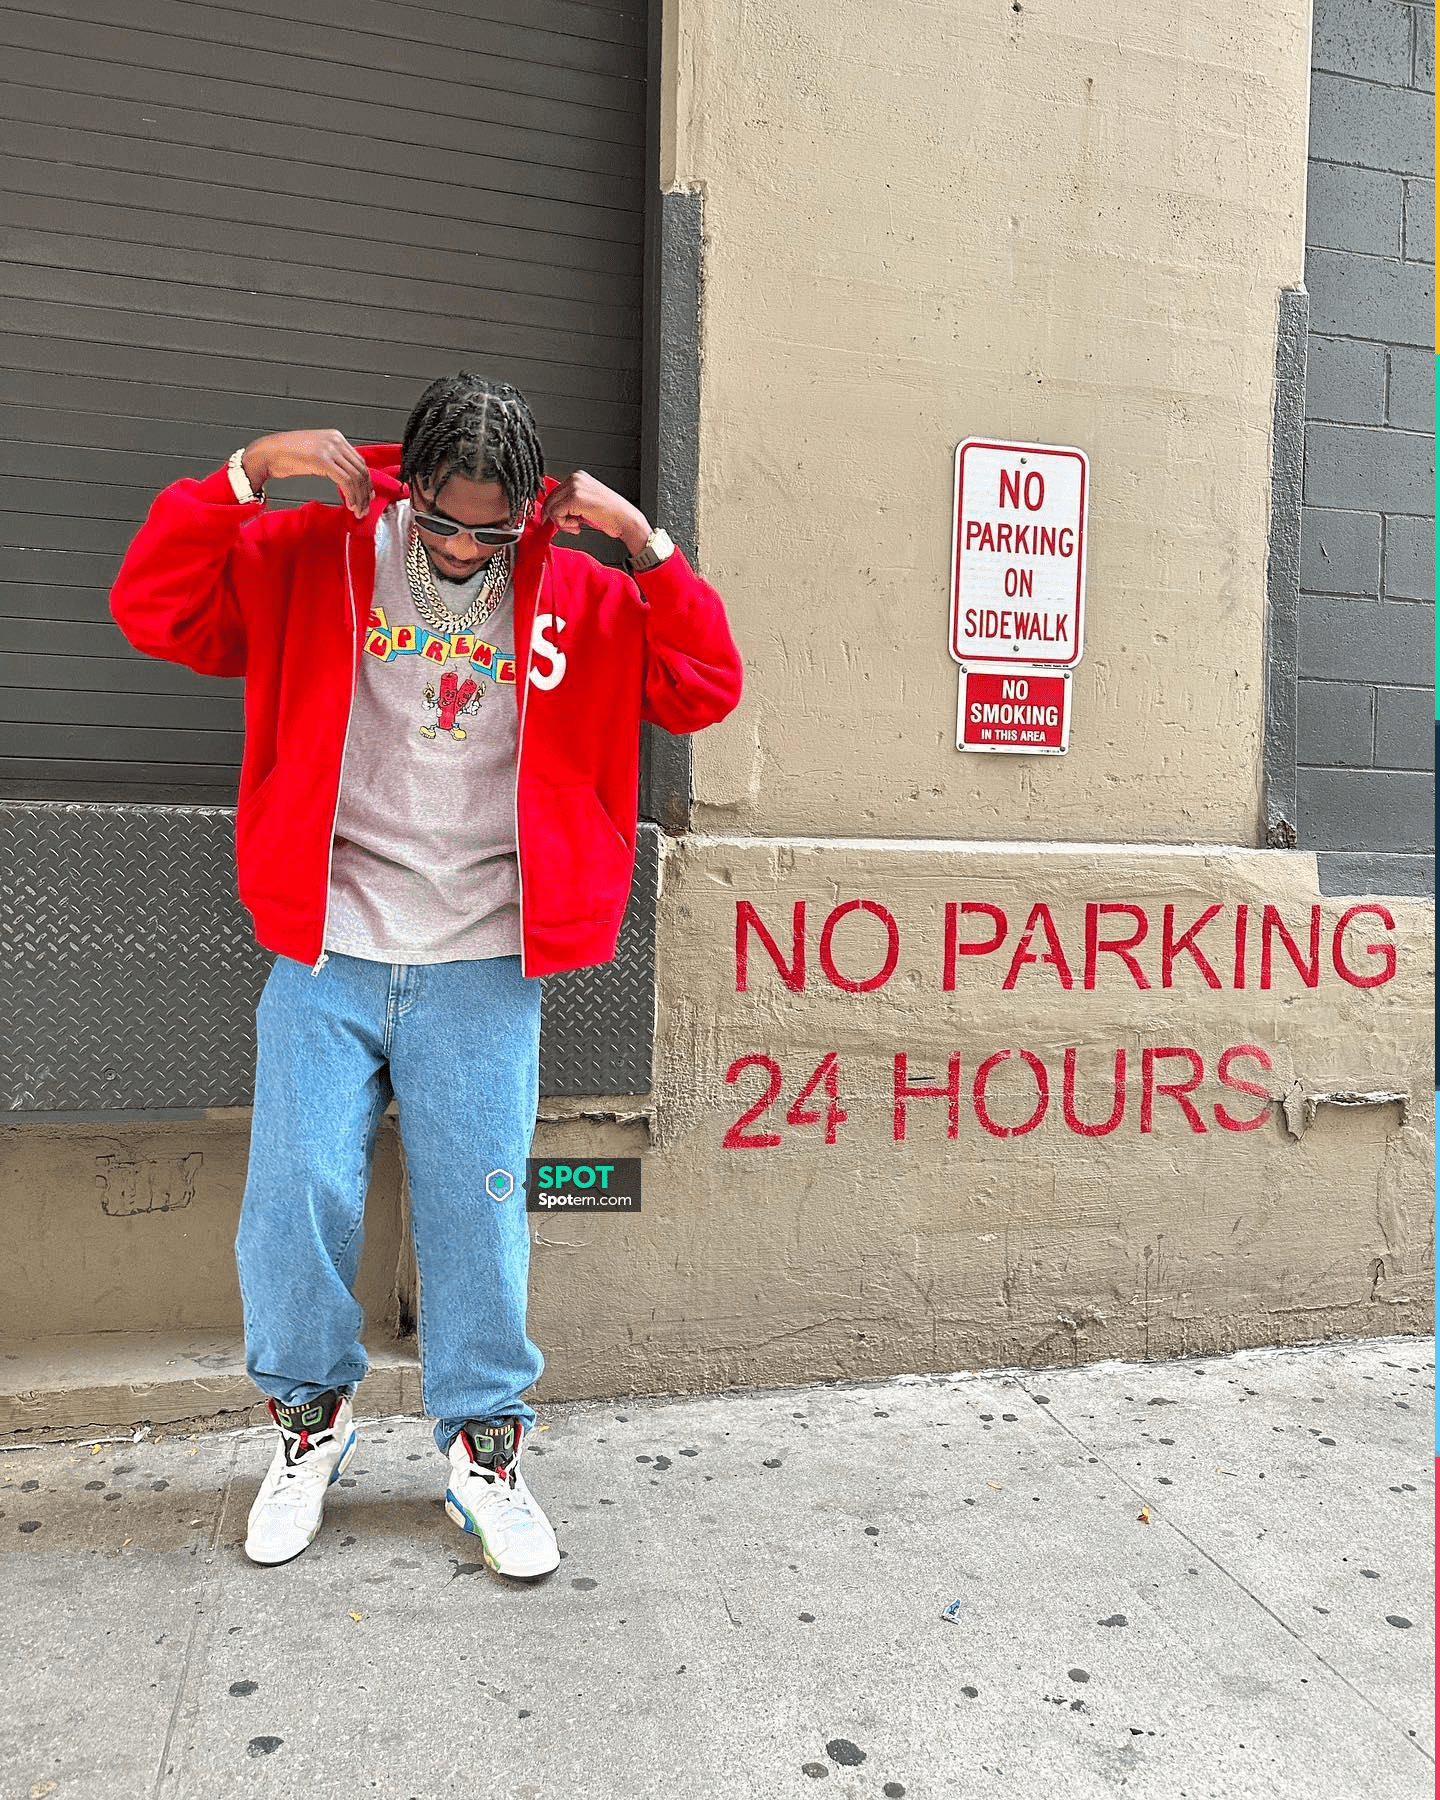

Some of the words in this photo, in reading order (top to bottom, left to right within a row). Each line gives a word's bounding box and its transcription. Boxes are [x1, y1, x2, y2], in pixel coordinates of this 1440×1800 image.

[999, 469, 1044, 511] NO
[966, 521, 1073, 557] PARKING
[1004, 568, 1033, 597] ON
[965, 609, 1067, 641] SIDEWALK
[367, 610, 515, 681] SUPREME
[529, 614, 567, 691] S
[1002, 679, 1028, 700] NO
[970, 702, 1058, 726] SMOKING
[981, 728, 993, 740] IN
[994, 729, 1018, 741] THIS
[1020, 730, 1046, 742] AREA
[735, 899, 900, 993] NO
[943, 901, 1397, 991] PARKING
[723, 1052, 847, 1149] 24
[893, 1045, 1273, 1142] HOURS
